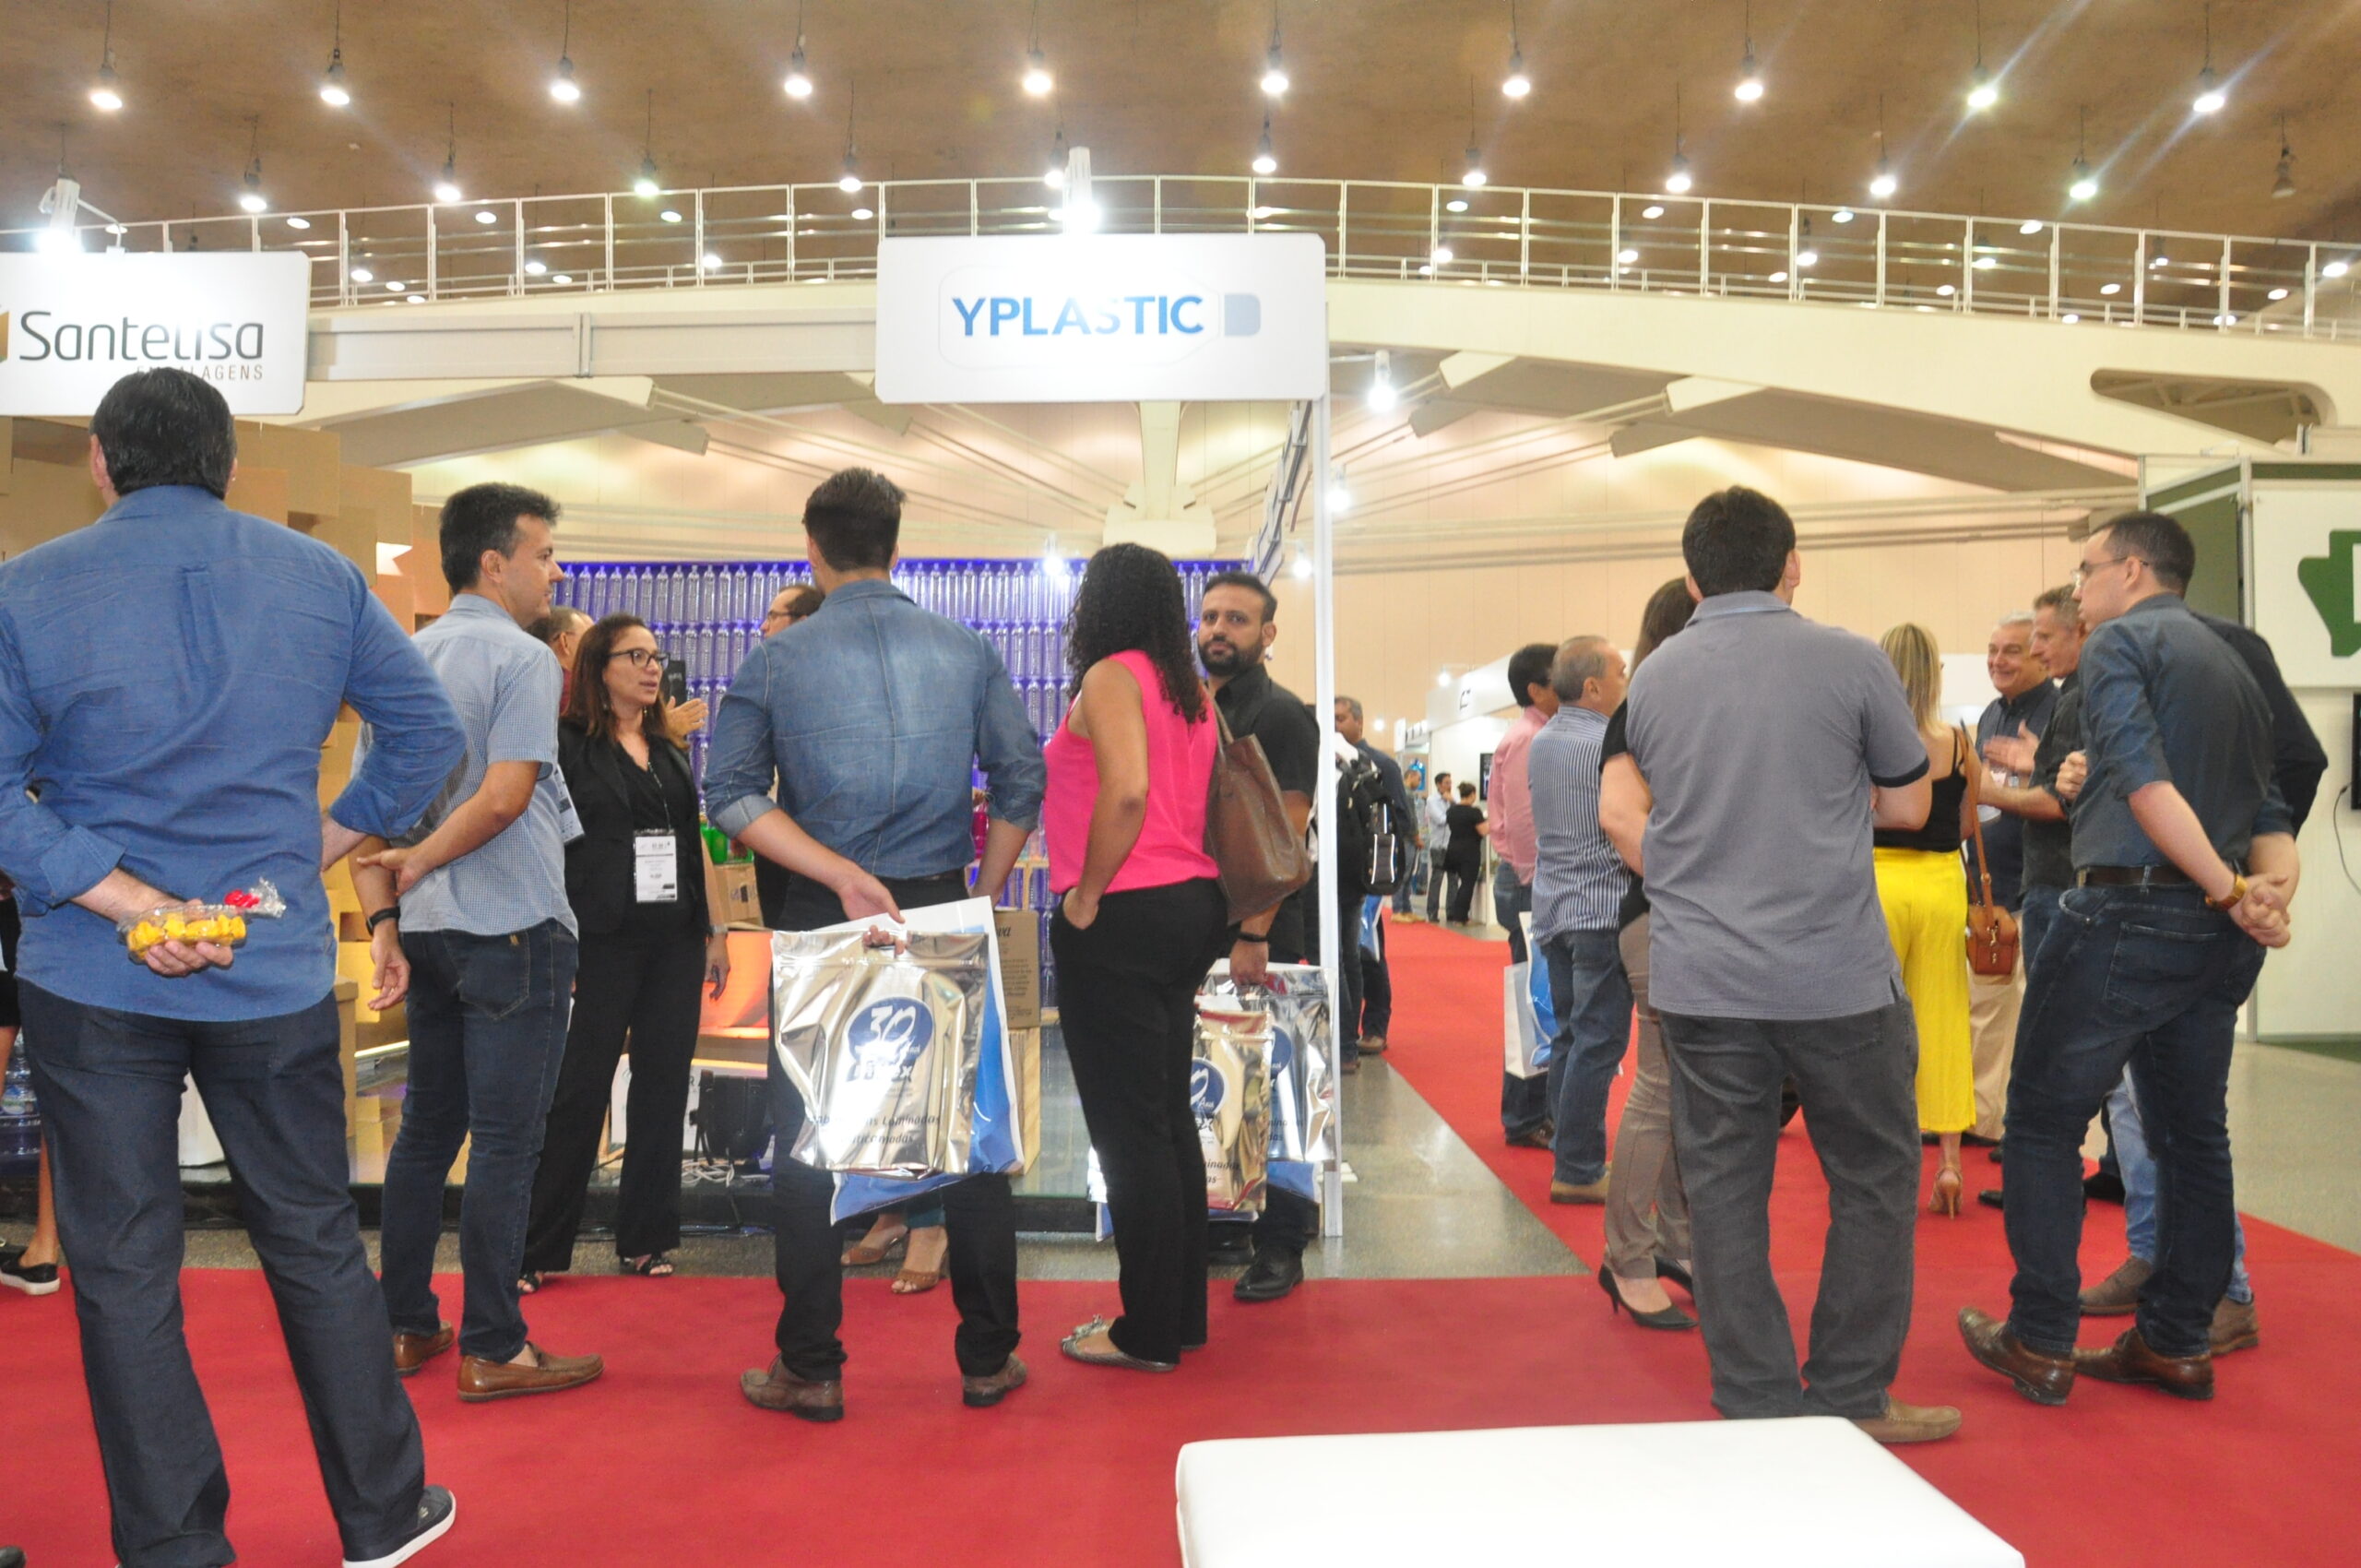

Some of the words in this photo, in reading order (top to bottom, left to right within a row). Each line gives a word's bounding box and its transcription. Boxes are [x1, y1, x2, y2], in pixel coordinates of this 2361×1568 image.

[19, 311, 264, 361] Santelisa
[952, 295, 1204, 337] YPLASTIC
[871, 1005, 917, 1042] 30
